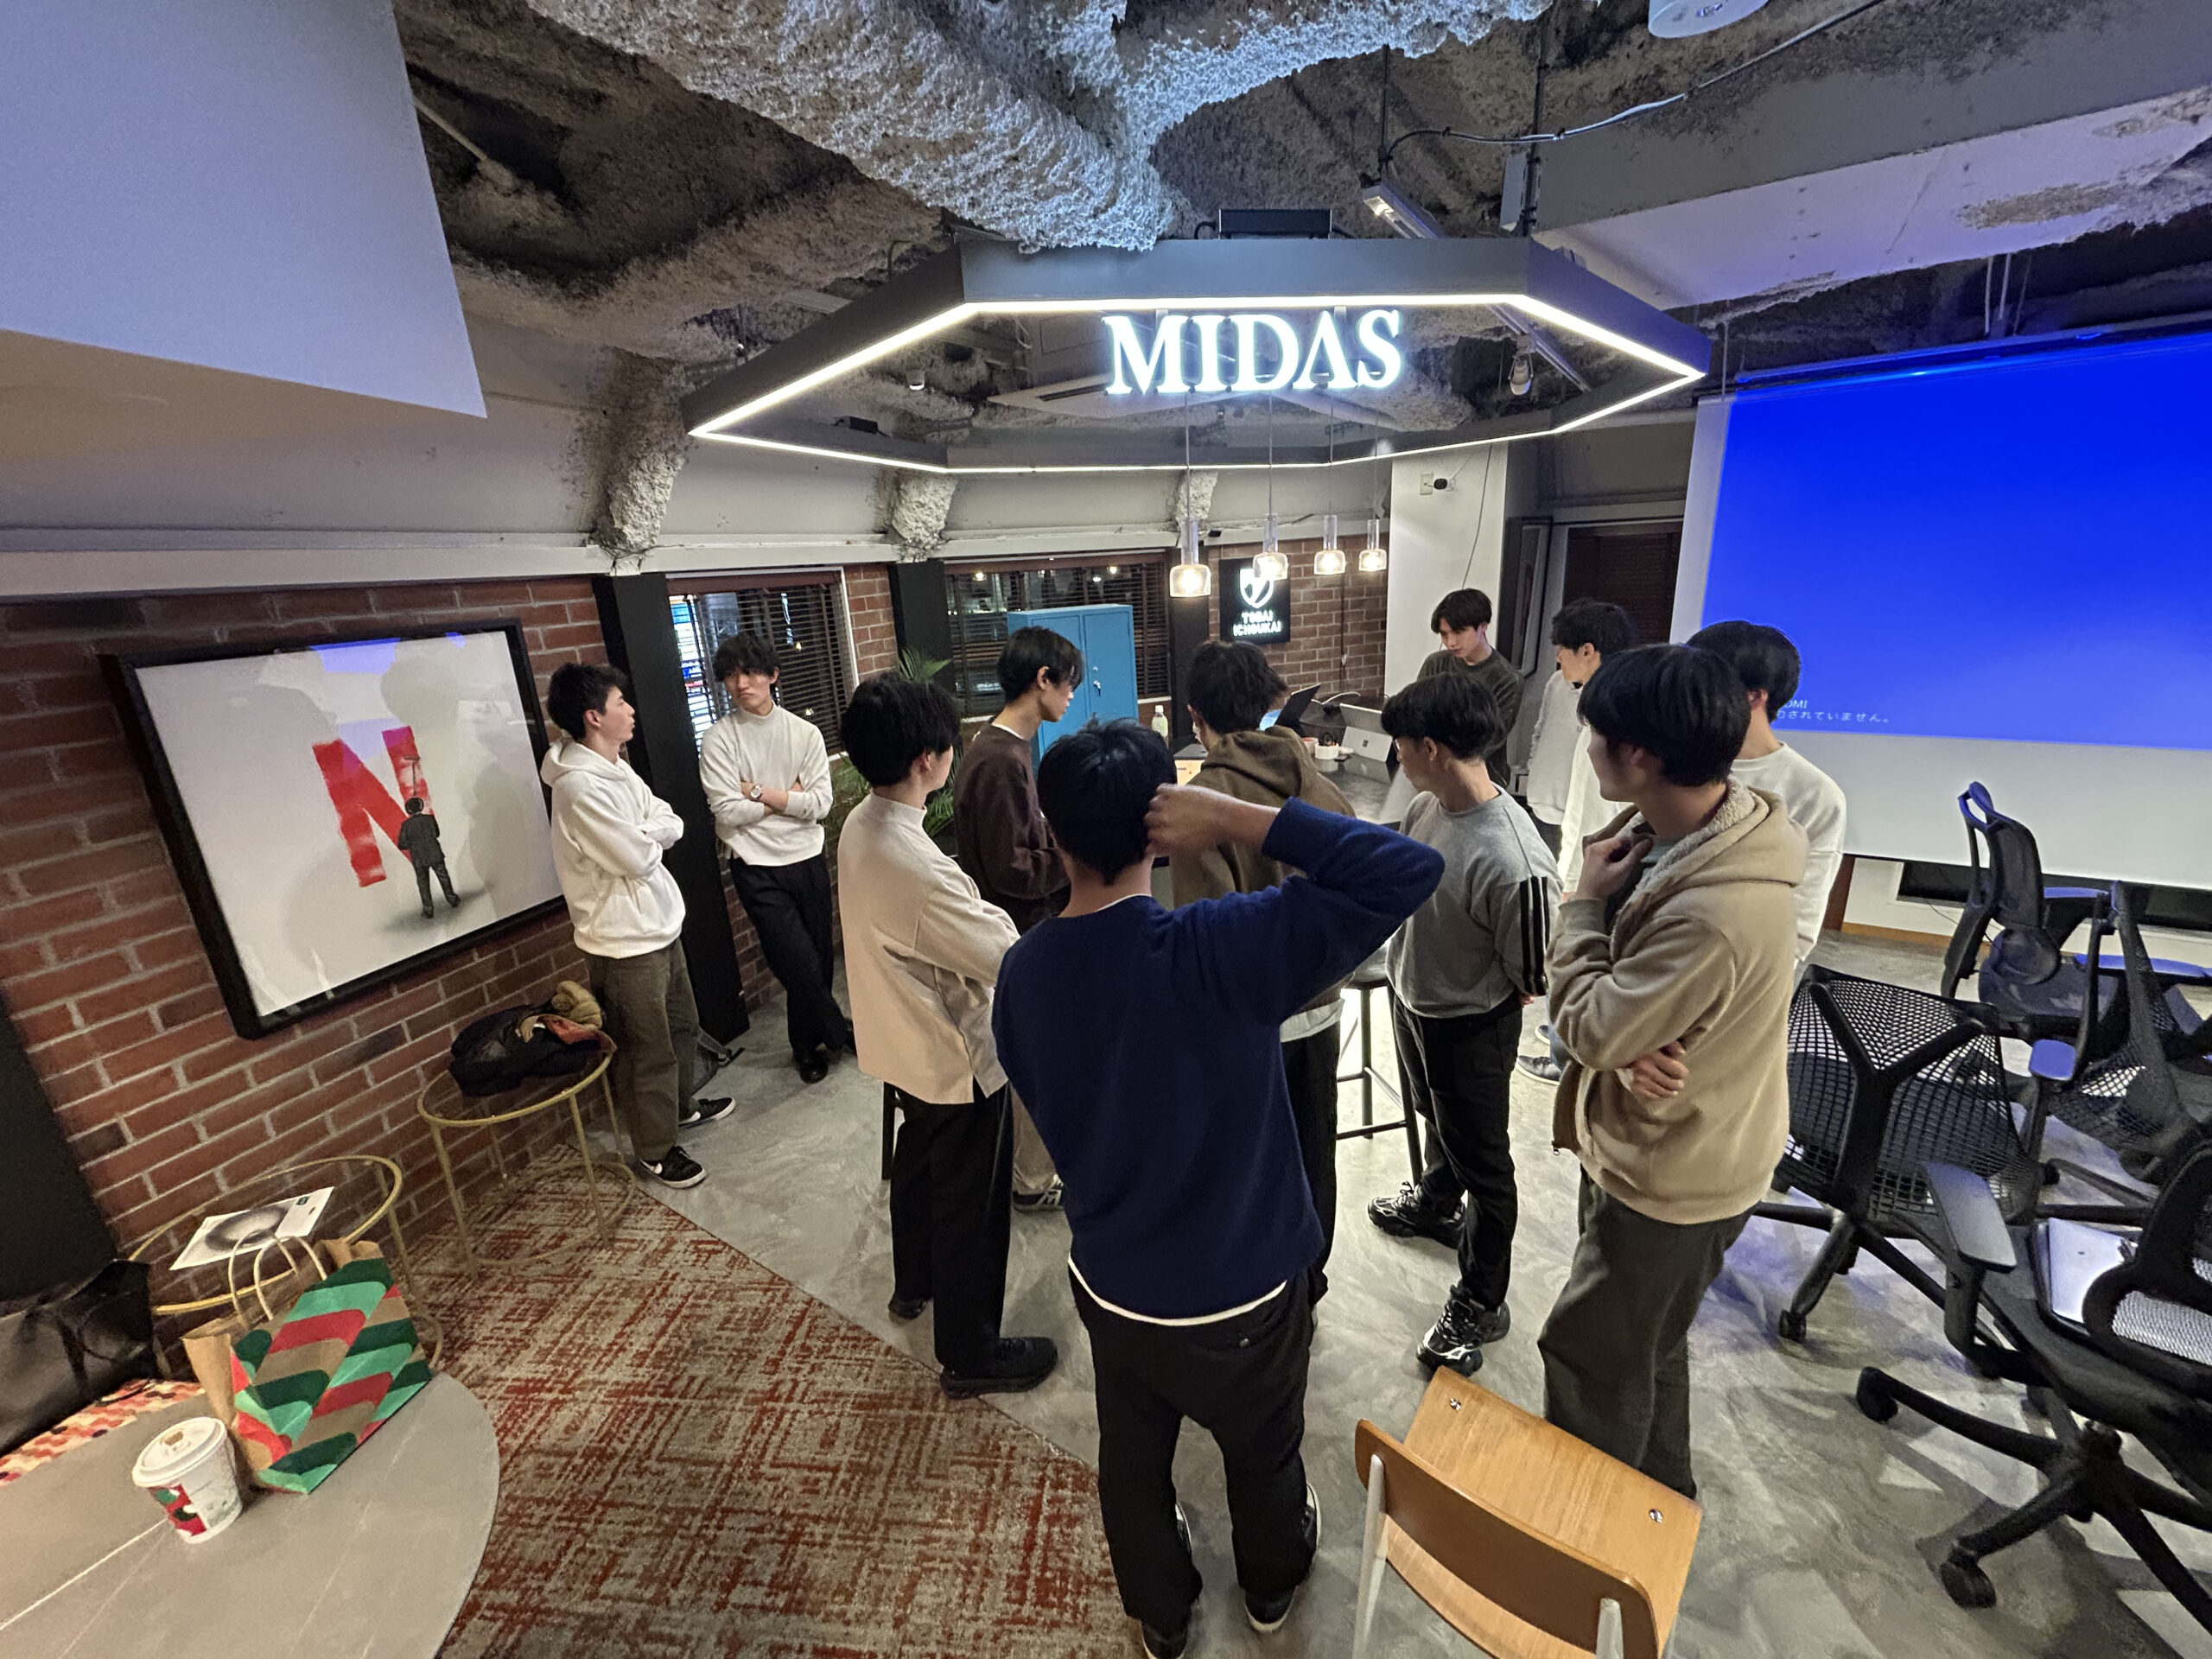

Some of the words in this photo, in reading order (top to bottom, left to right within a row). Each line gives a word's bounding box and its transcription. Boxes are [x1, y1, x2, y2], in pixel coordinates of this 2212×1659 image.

[1100, 308, 1403, 396] MIDAS
[1783, 699, 1808, 709] DMI
[312, 725, 435, 888] N
